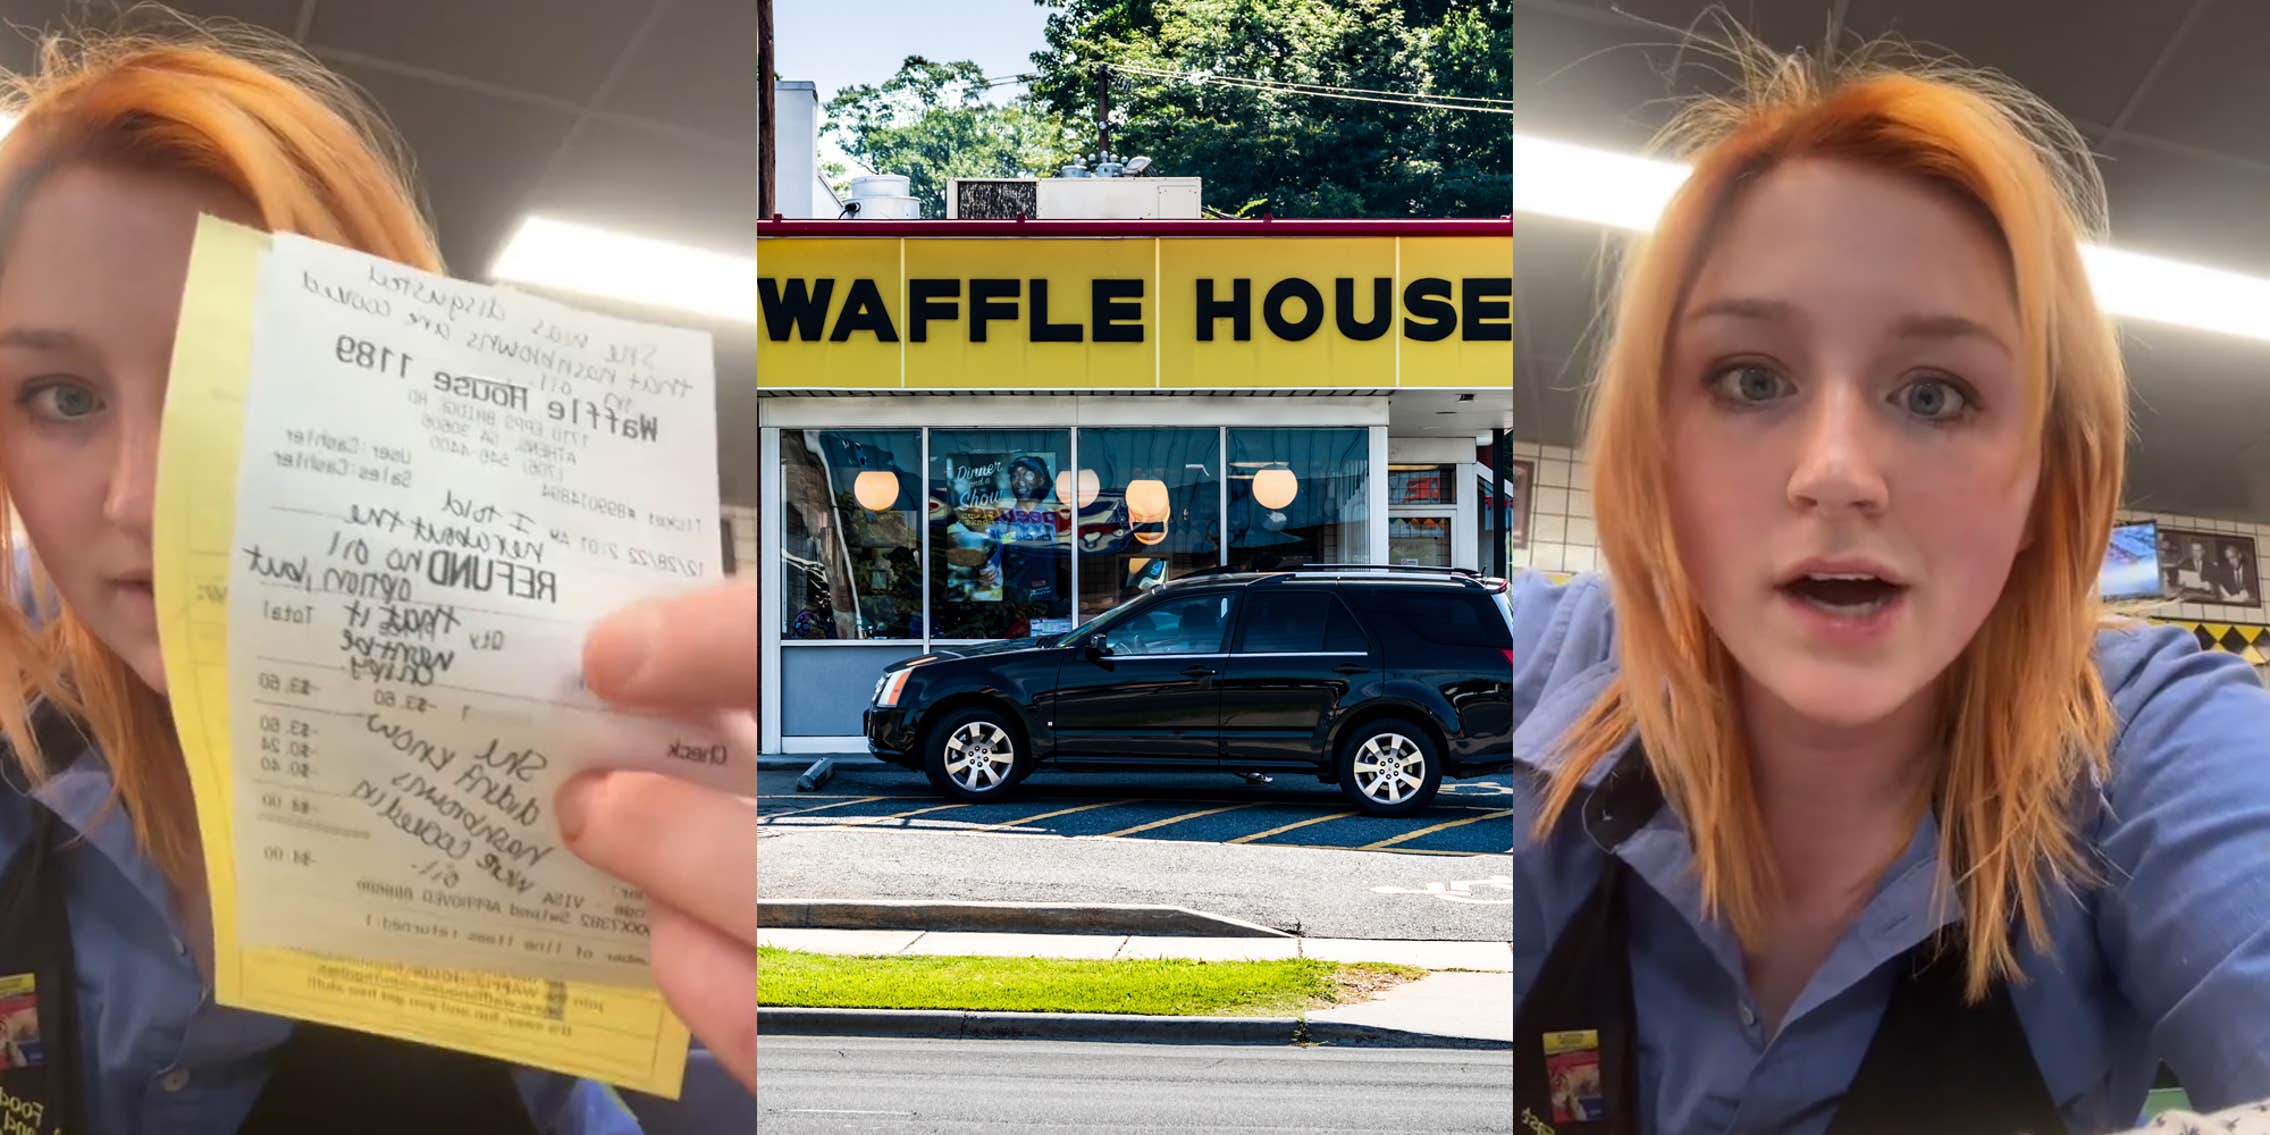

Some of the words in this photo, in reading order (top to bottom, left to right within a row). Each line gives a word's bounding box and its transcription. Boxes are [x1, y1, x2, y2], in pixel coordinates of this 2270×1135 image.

[757, 277, 1145, 343] WAFFLE
[1196, 276, 1513, 342] HOUSE
[957, 461, 1001, 482] Dinner
